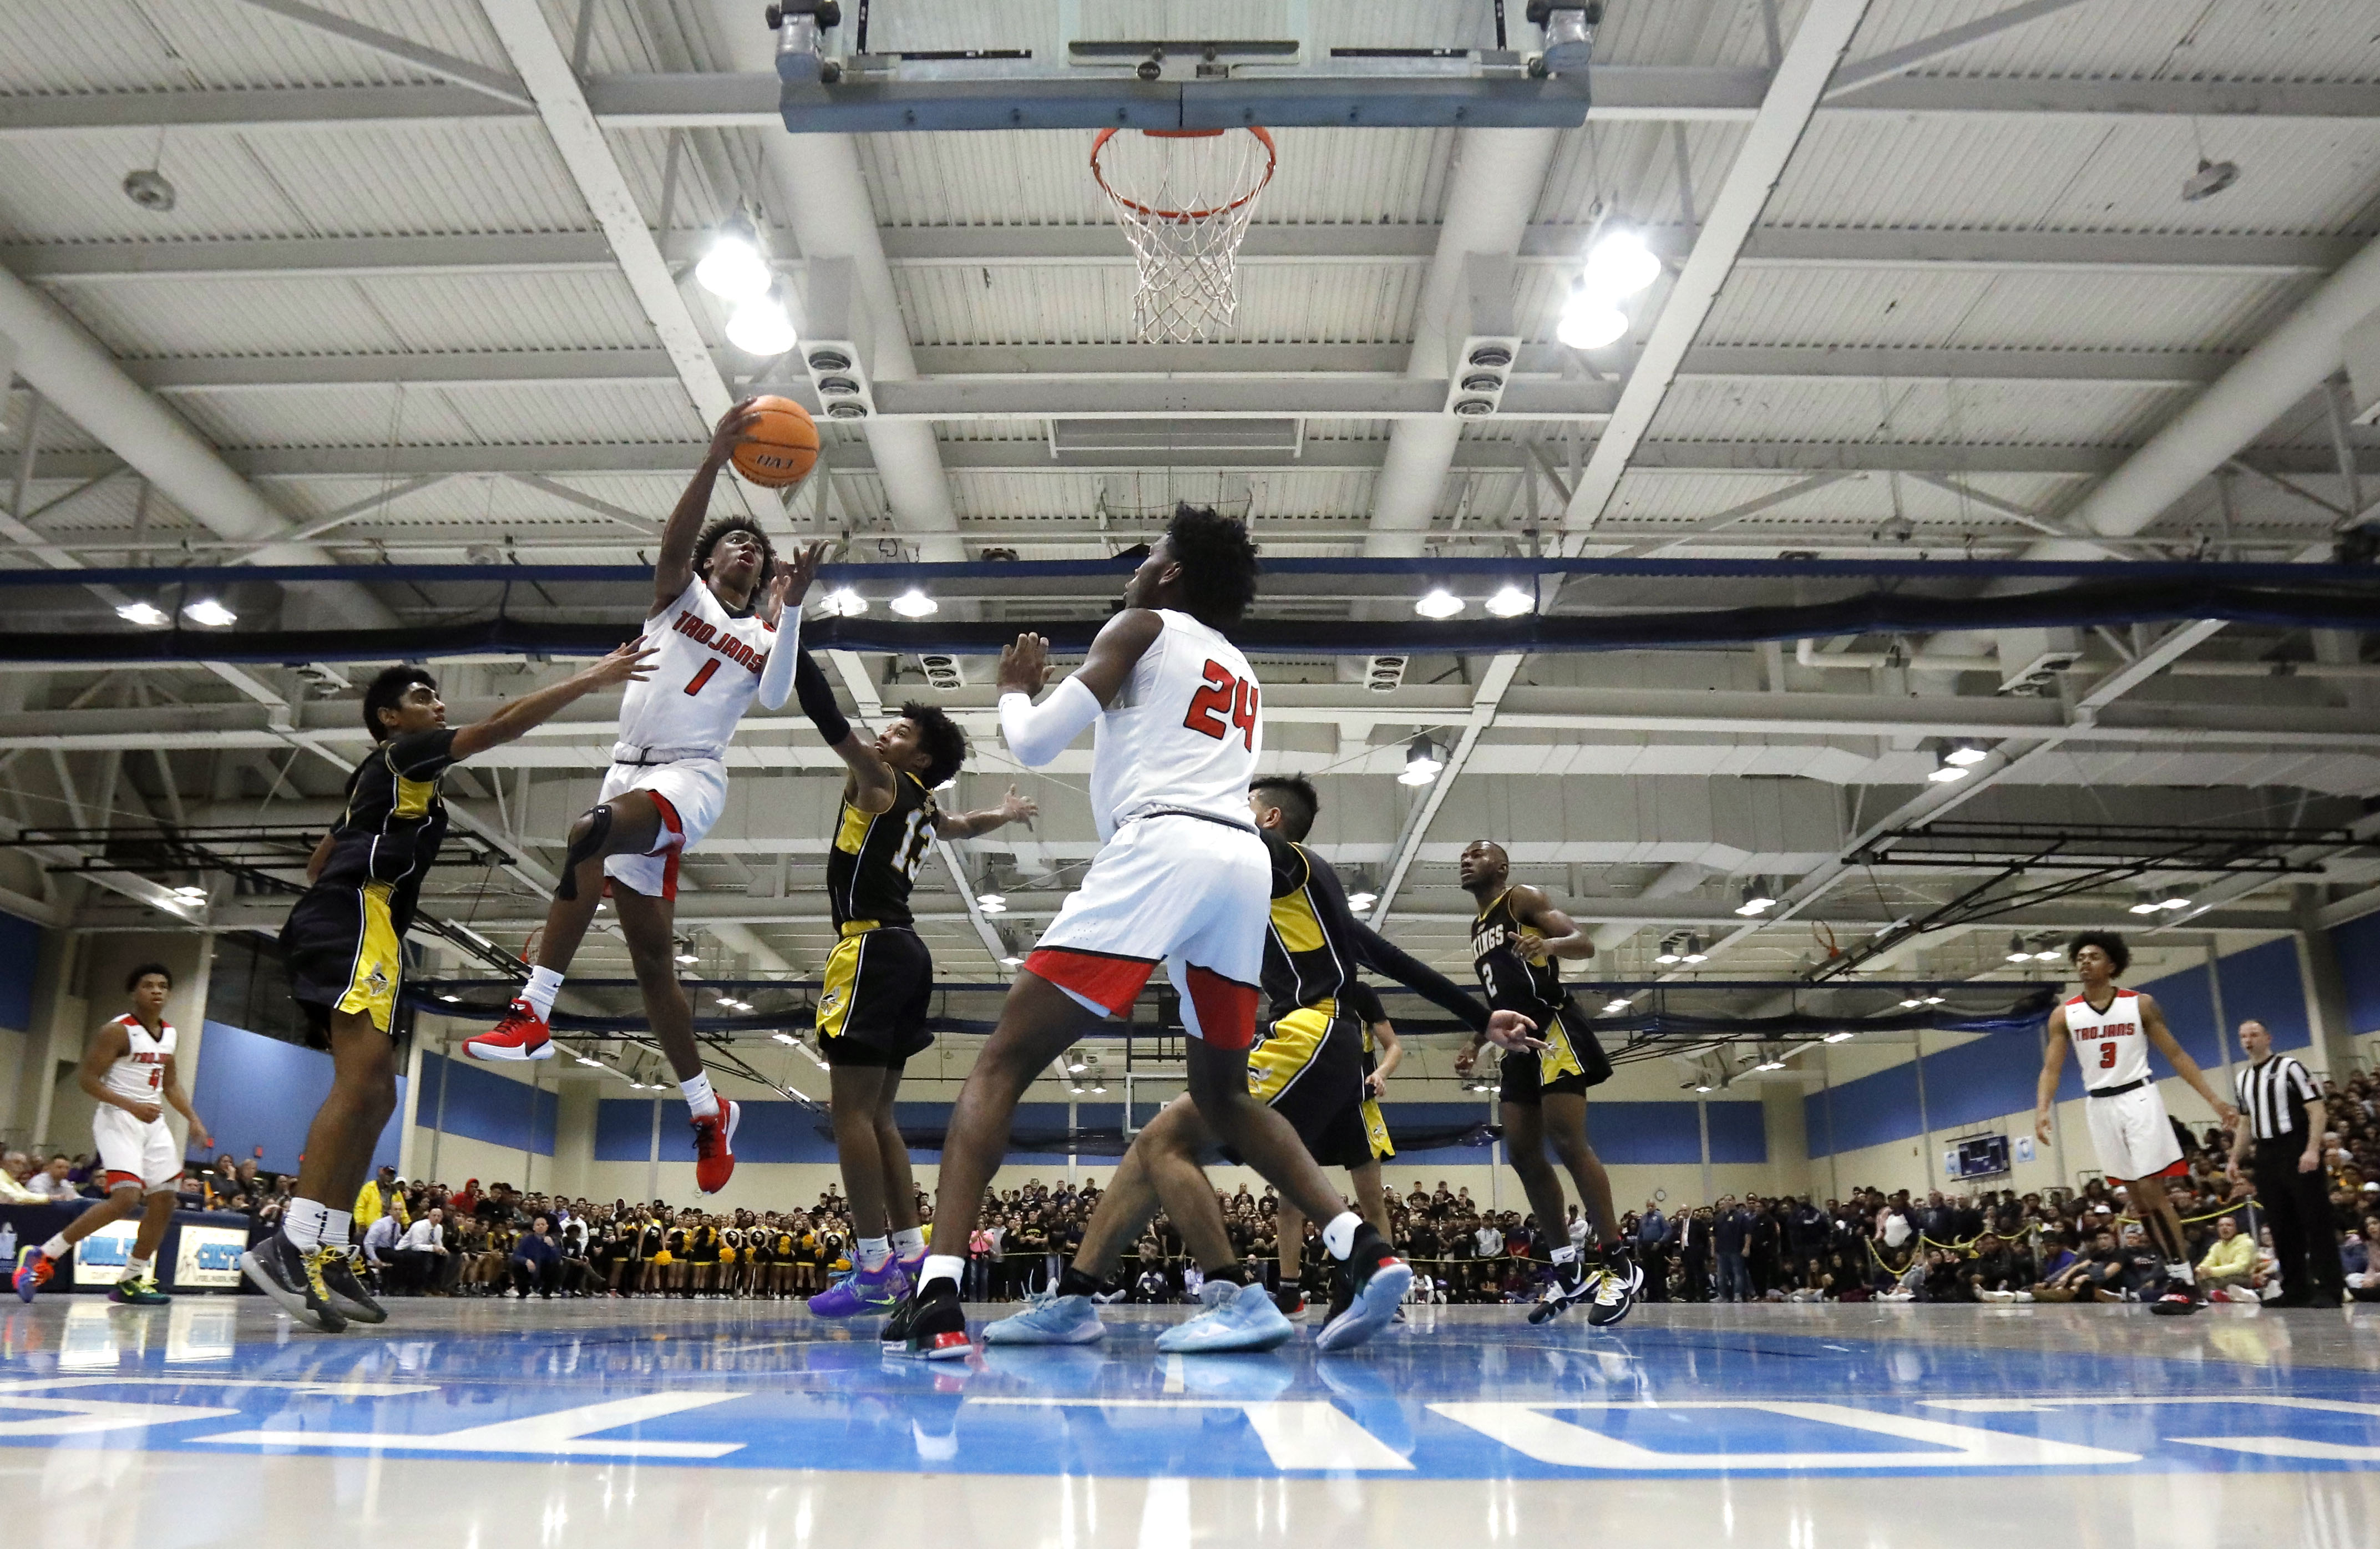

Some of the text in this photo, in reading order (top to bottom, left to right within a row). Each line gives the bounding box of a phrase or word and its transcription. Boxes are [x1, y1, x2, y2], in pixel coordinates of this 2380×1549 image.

[672, 610, 764, 674] TROJANS
[683, 657, 721, 697] 1
[1183, 658, 1259, 753] 24
[891, 808, 936, 883] 13
[1471, 924, 1504, 963] KINGS
[1482, 963, 1498, 998] 2
[2074, 1022, 2135, 1041] TROJANS
[2100, 1041, 2116, 1069] 3
